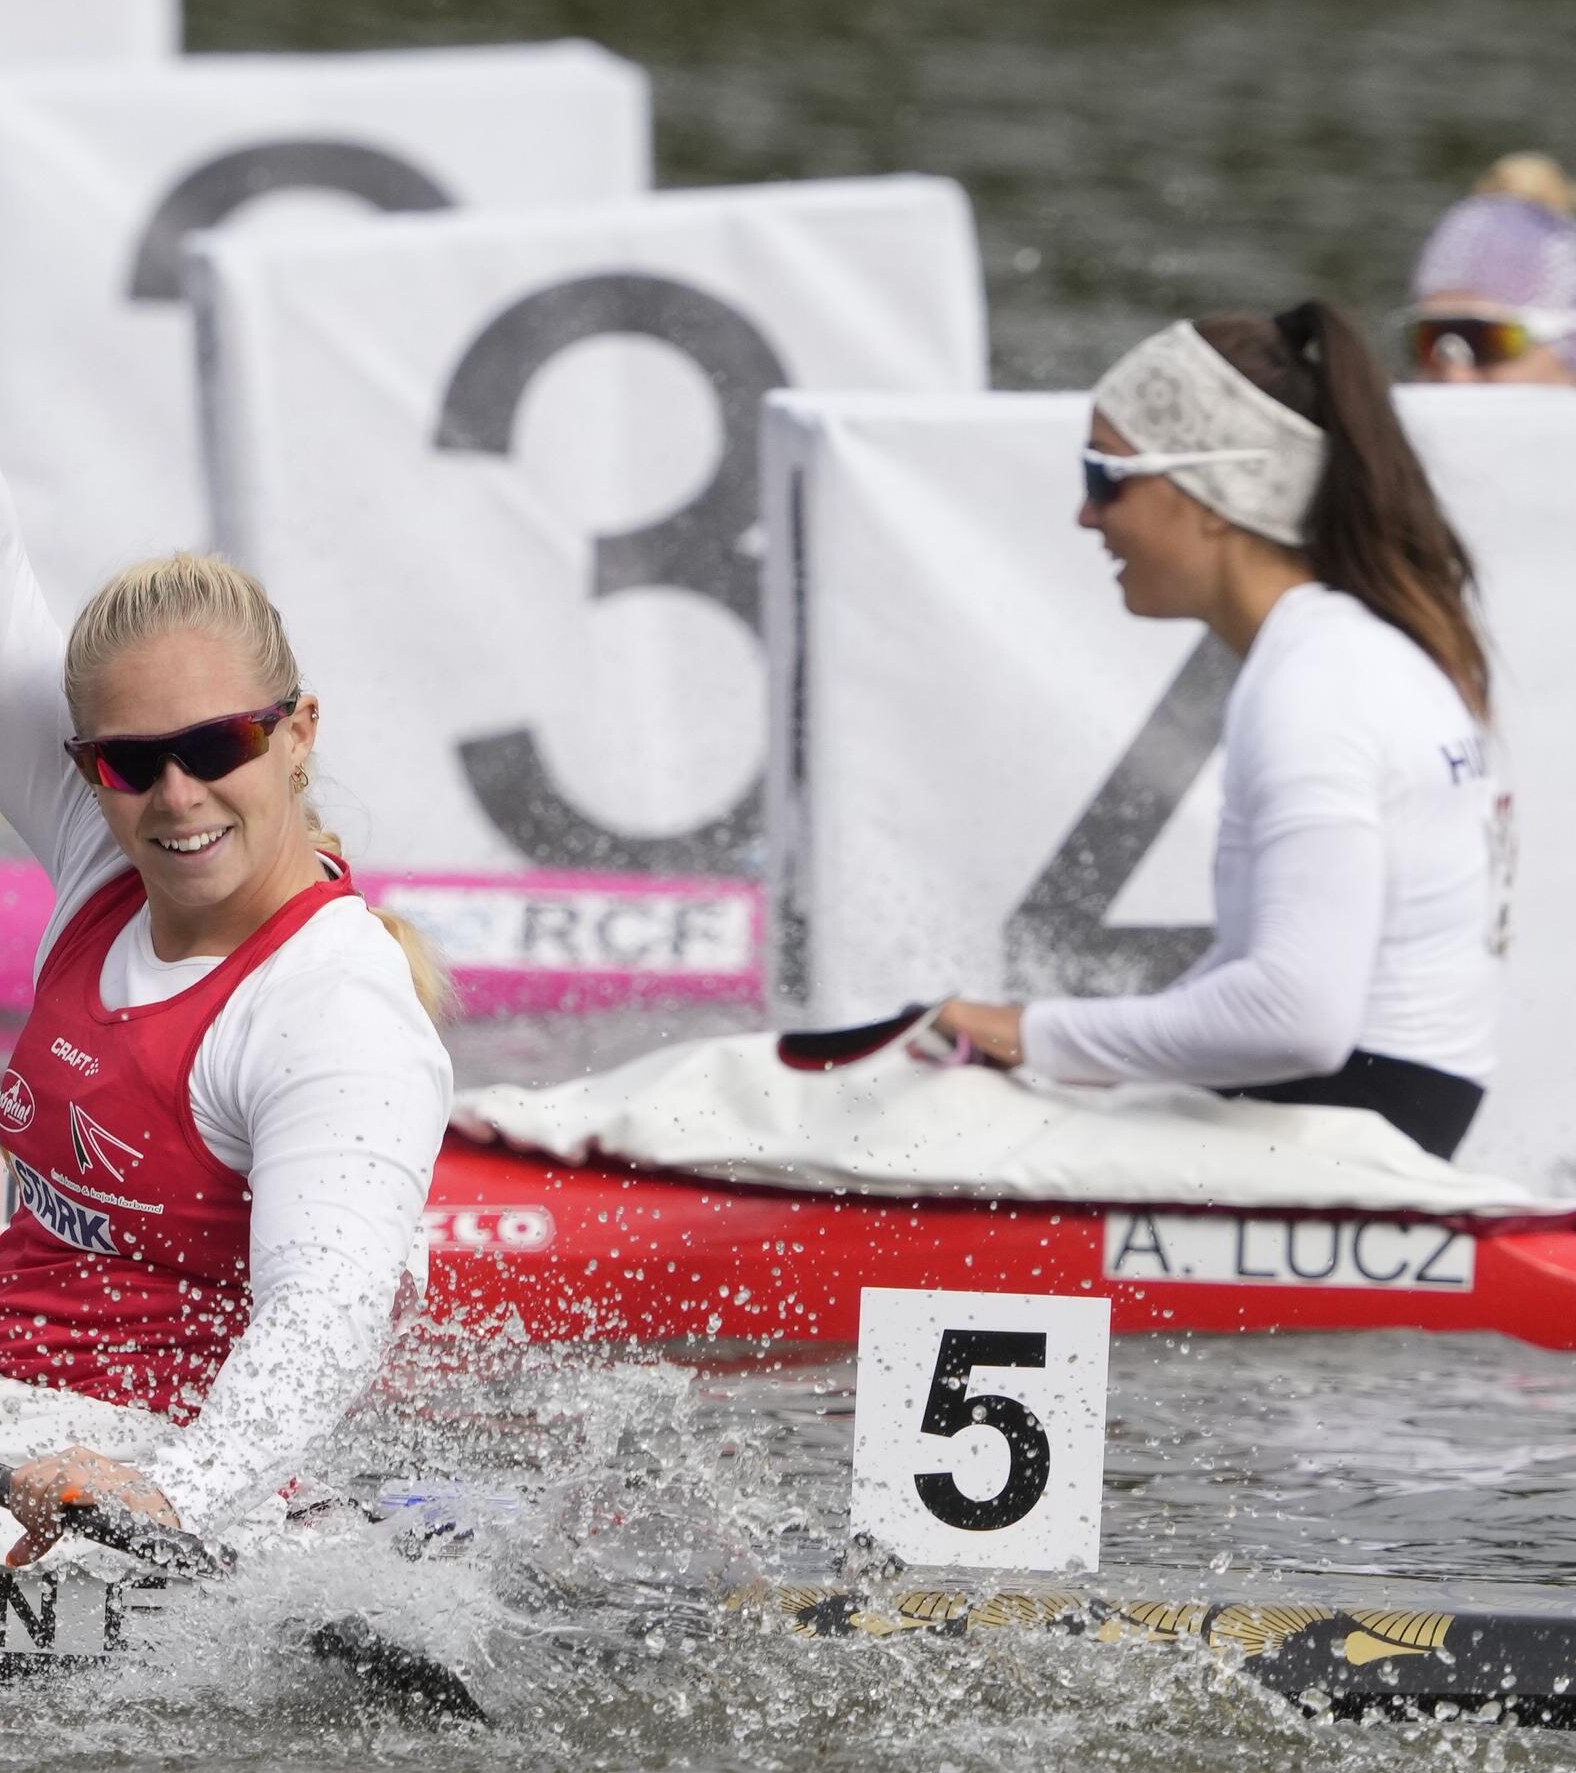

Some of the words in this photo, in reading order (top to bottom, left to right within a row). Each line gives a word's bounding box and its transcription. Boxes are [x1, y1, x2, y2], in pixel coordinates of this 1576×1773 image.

[433, 270, 788, 874] 3
[50, 1036, 93, 1071] CRAFT
[15, 1159, 119, 1253] STARK
[424, 1211, 549, 1246] ELO
[1114, 1204, 1192, 1275] A.
[1237, 1214, 1465, 1285] LUCZ
[914, 1328, 1051, 1531] 5
